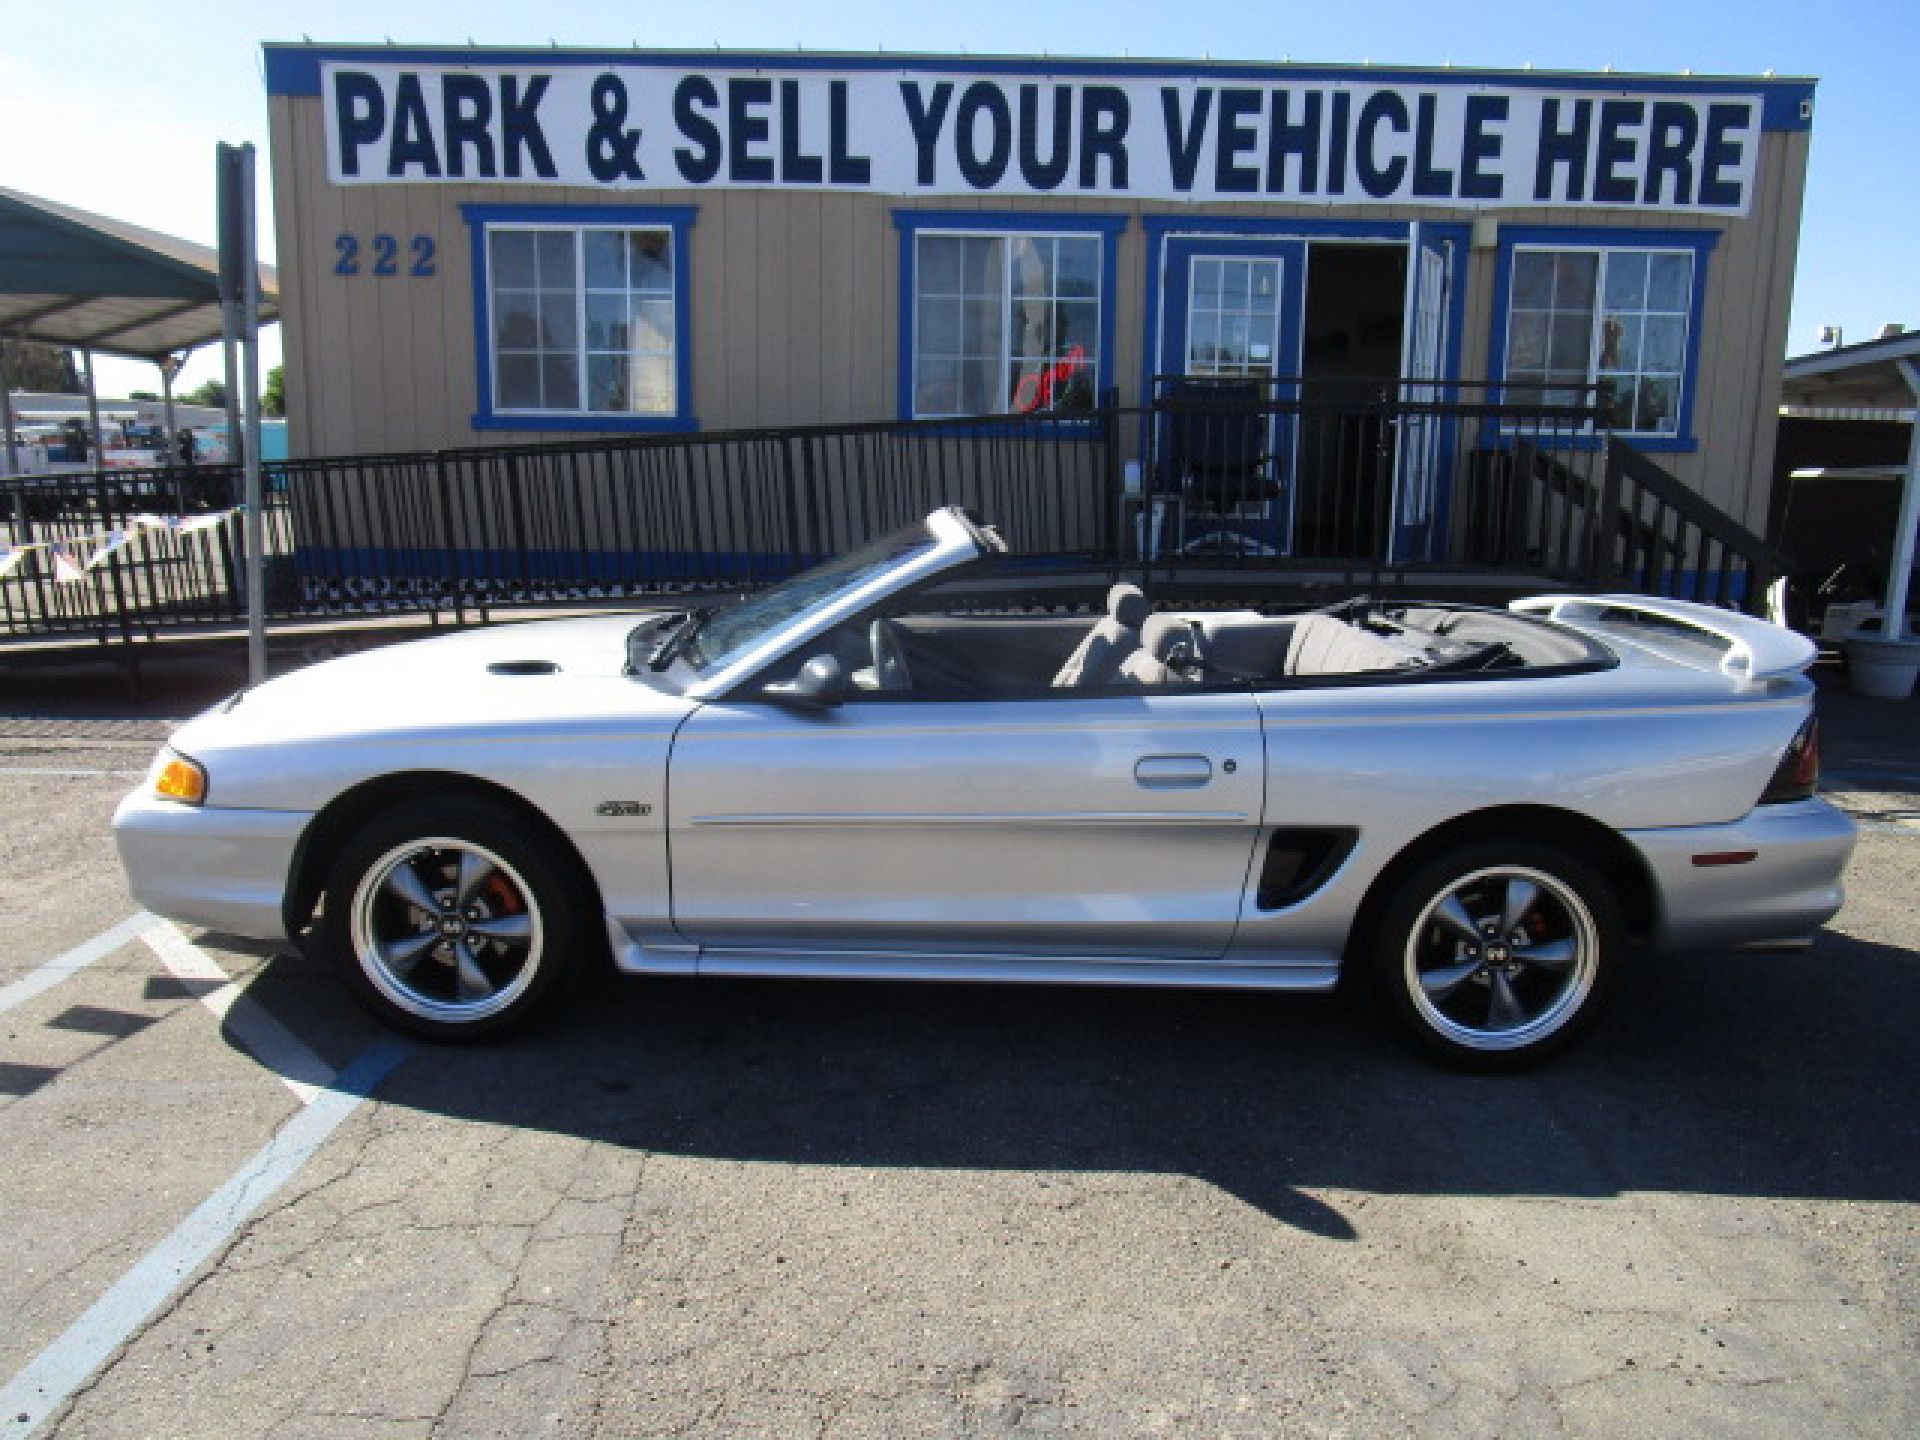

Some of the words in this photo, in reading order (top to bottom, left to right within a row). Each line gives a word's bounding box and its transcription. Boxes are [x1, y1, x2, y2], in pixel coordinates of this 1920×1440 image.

[334, 70, 558, 178] PARK
[585, 72, 646, 182] &
[672, 74, 872, 184] SELL
[900, 80, 1131, 190] YOUR
[1160, 86, 1510, 199] VEHICLE
[1533, 98, 1752, 208] HERE
[333, 234, 436, 277] 222
